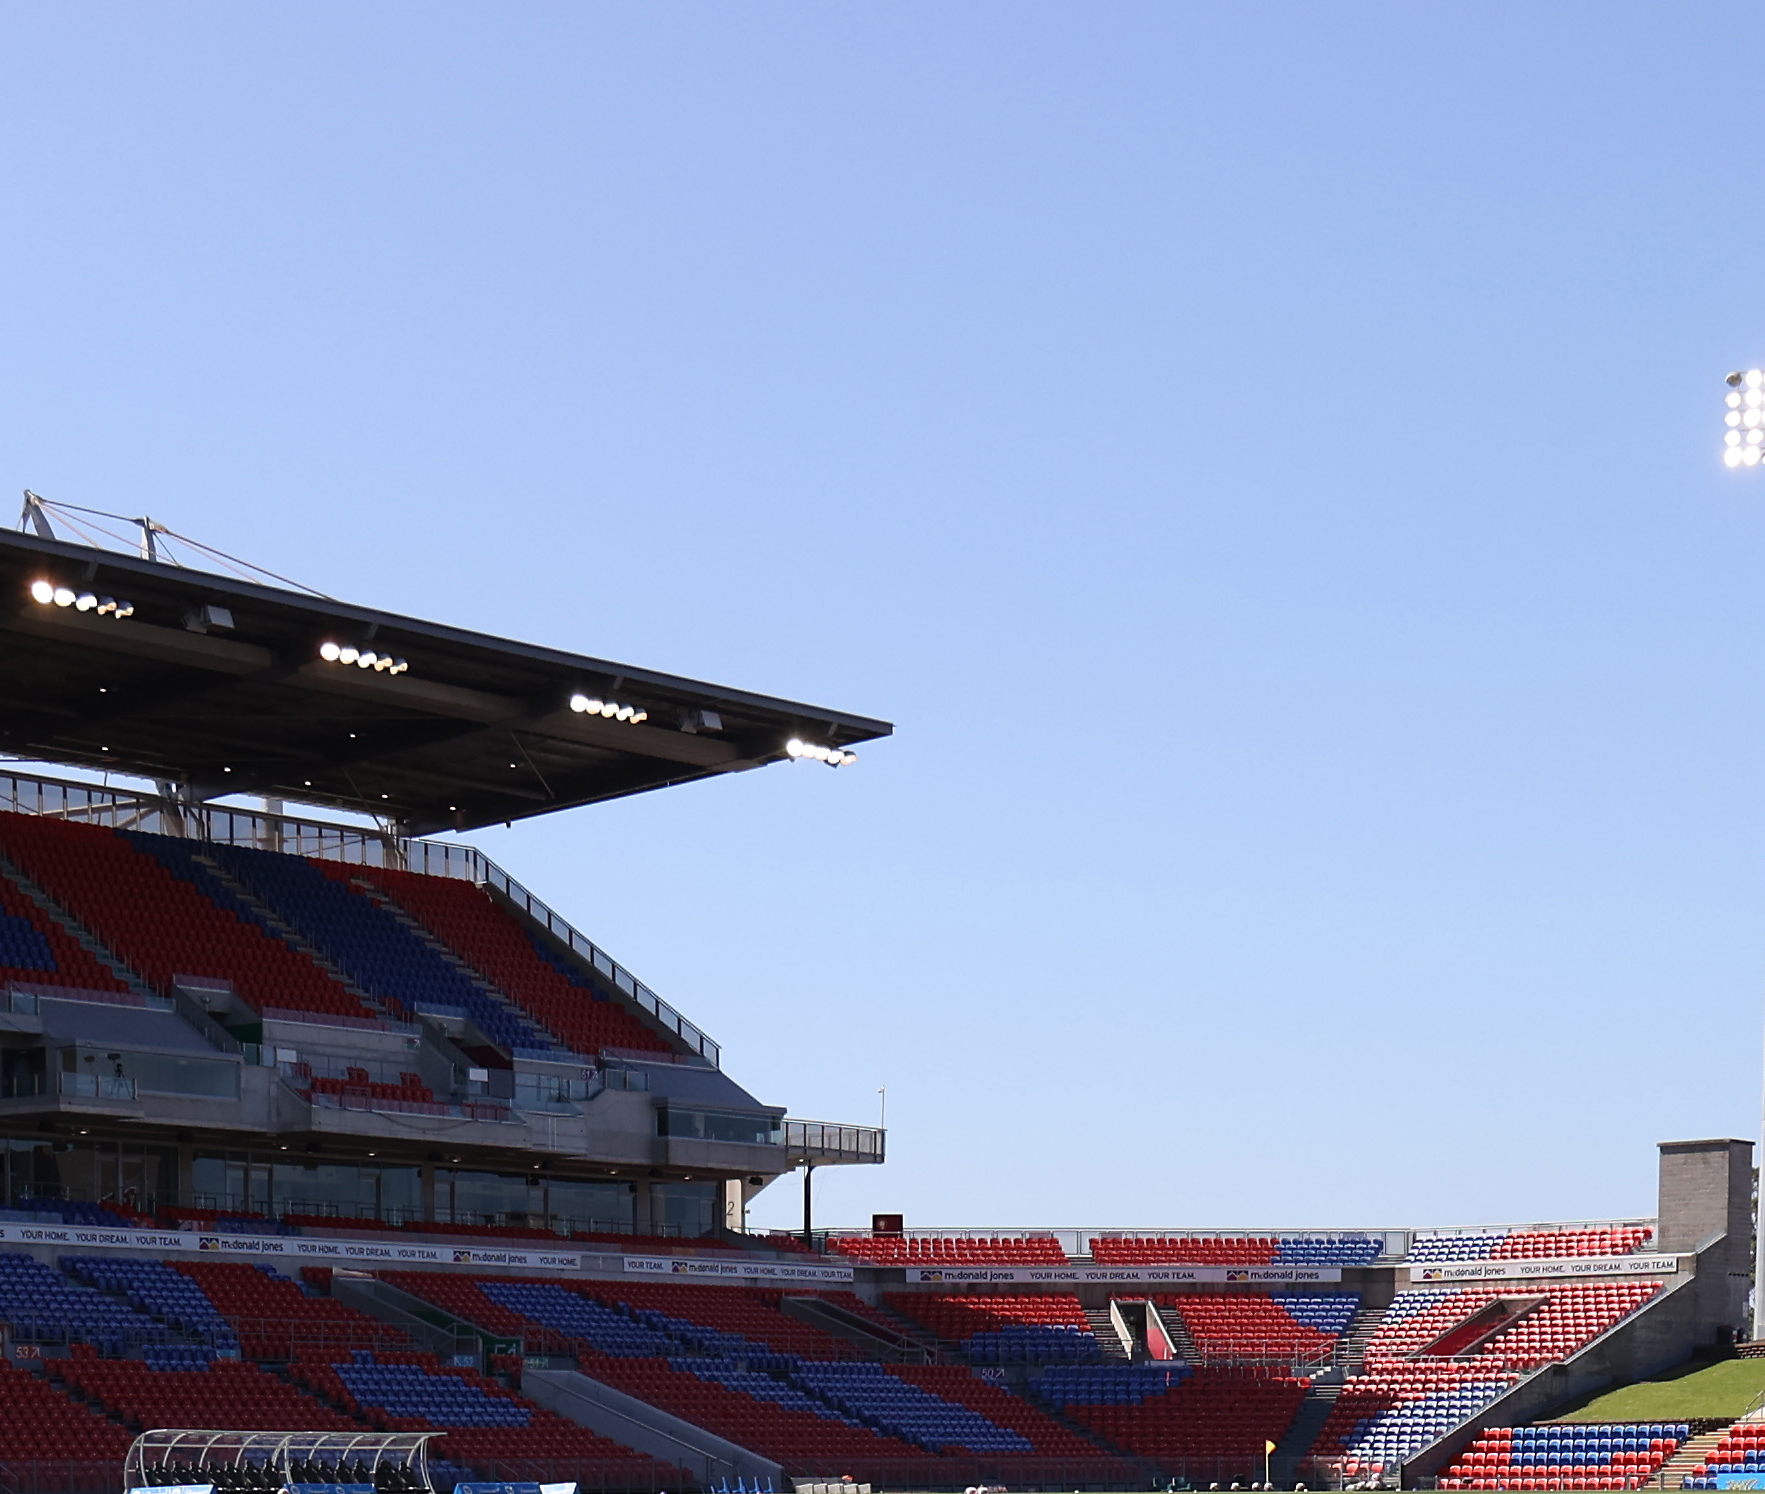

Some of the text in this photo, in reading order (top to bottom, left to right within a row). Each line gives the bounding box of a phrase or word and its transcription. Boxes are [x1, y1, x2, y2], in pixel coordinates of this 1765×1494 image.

[726, 1201, 735, 1216] 2
[21, 1229, 43, 1239] YOUR
[76, 1232, 97, 1242] YOUR
[136, 1235, 156, 1246] YOUR
[261, 1241, 283, 1253] jones
[297, 1244, 317, 1253] YOUR
[345, 1246, 364, 1256] YOUR
[397, 1249, 415, 1258] YOUR
[508, 1253, 527, 1265] jones
[539, 1256, 557, 1265] YOUR
[627, 1261, 645, 1269] YOUR
[720, 1264, 737, 1274] jones
[743, 1266, 758, 1275] YOUR
[1483, 1266, 1506, 1279] jones
[1520, 1265, 1540, 1274] YOUR
[1570, 1264, 1591, 1273] YOUR
[1629, 1262, 1648, 1271] YOUR
[989, 1270, 1014, 1282] jones
[1030, 1271, 1052, 1280] YOUR
[1085, 1271, 1107, 1280] YOUR
[1147, 1271, 1169, 1280] YOUR
[1294, 1269, 1319, 1282] jones
[16, 1346, 29, 1358] 53
